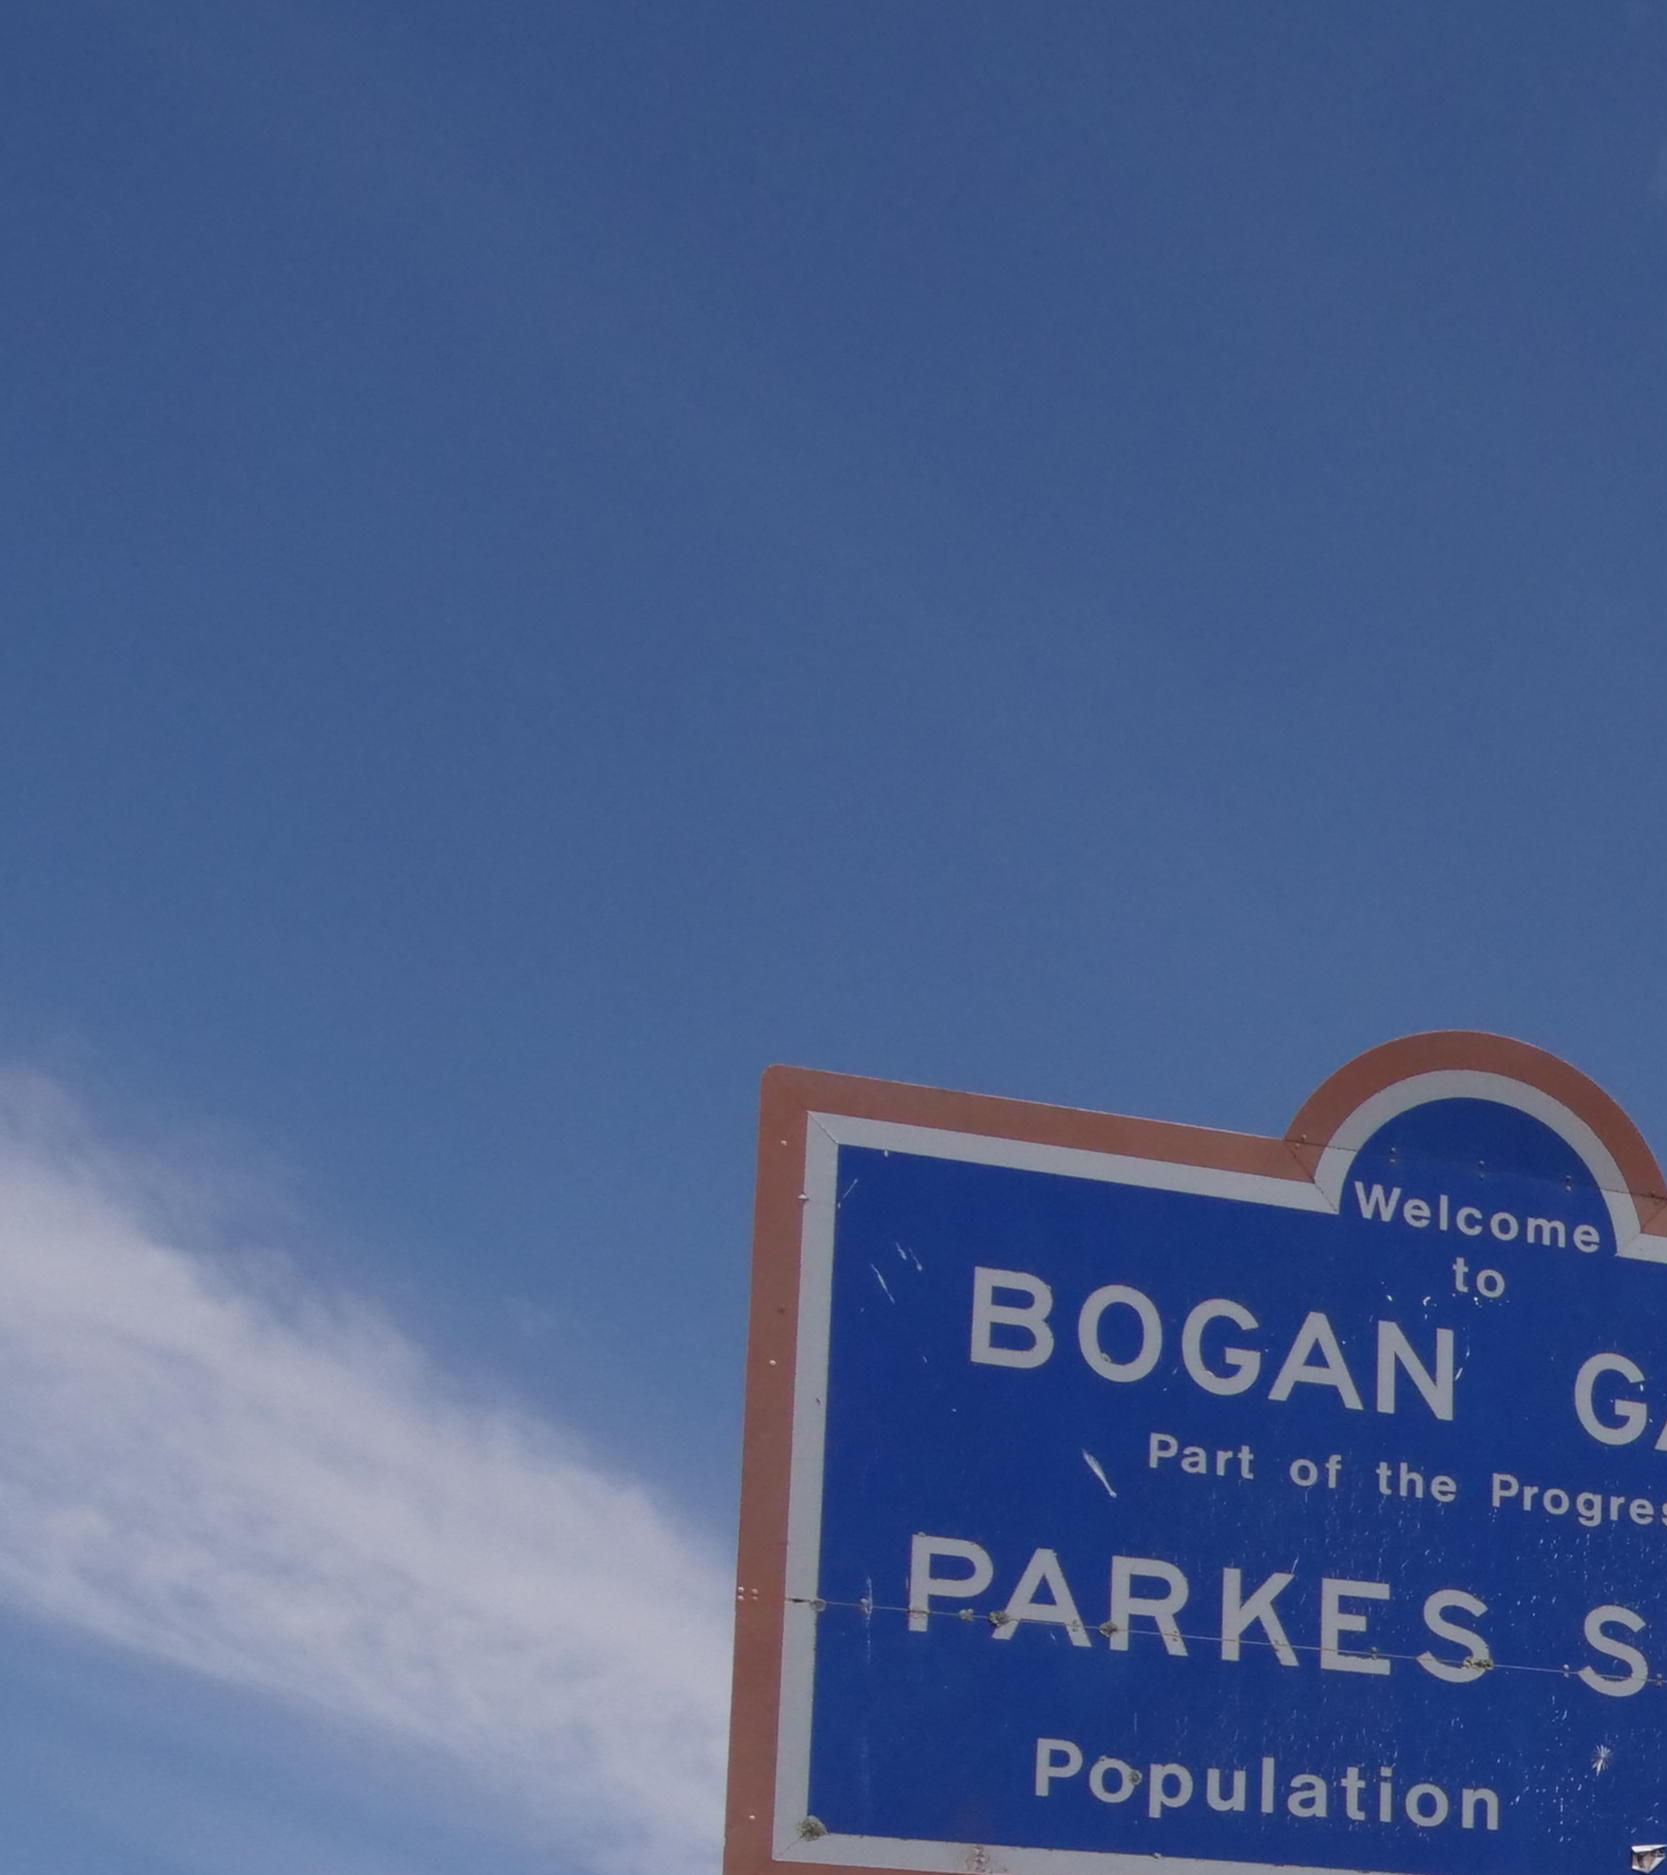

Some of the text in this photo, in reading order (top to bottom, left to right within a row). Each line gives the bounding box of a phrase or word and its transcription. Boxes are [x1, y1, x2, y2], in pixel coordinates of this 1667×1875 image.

[1356, 1182, 1600, 1253] Welcome
[1454, 1256, 1506, 1299] to
[970, 1266, 1455, 1421] BOGAN
[1148, 1433, 1255, 1484] Part
[1290, 1454, 1342, 1490] of
[1376, 1462, 1458, 1504] the
[908, 1531, 1491, 1684] PARKES
[1034, 1737, 1500, 1831] Population
